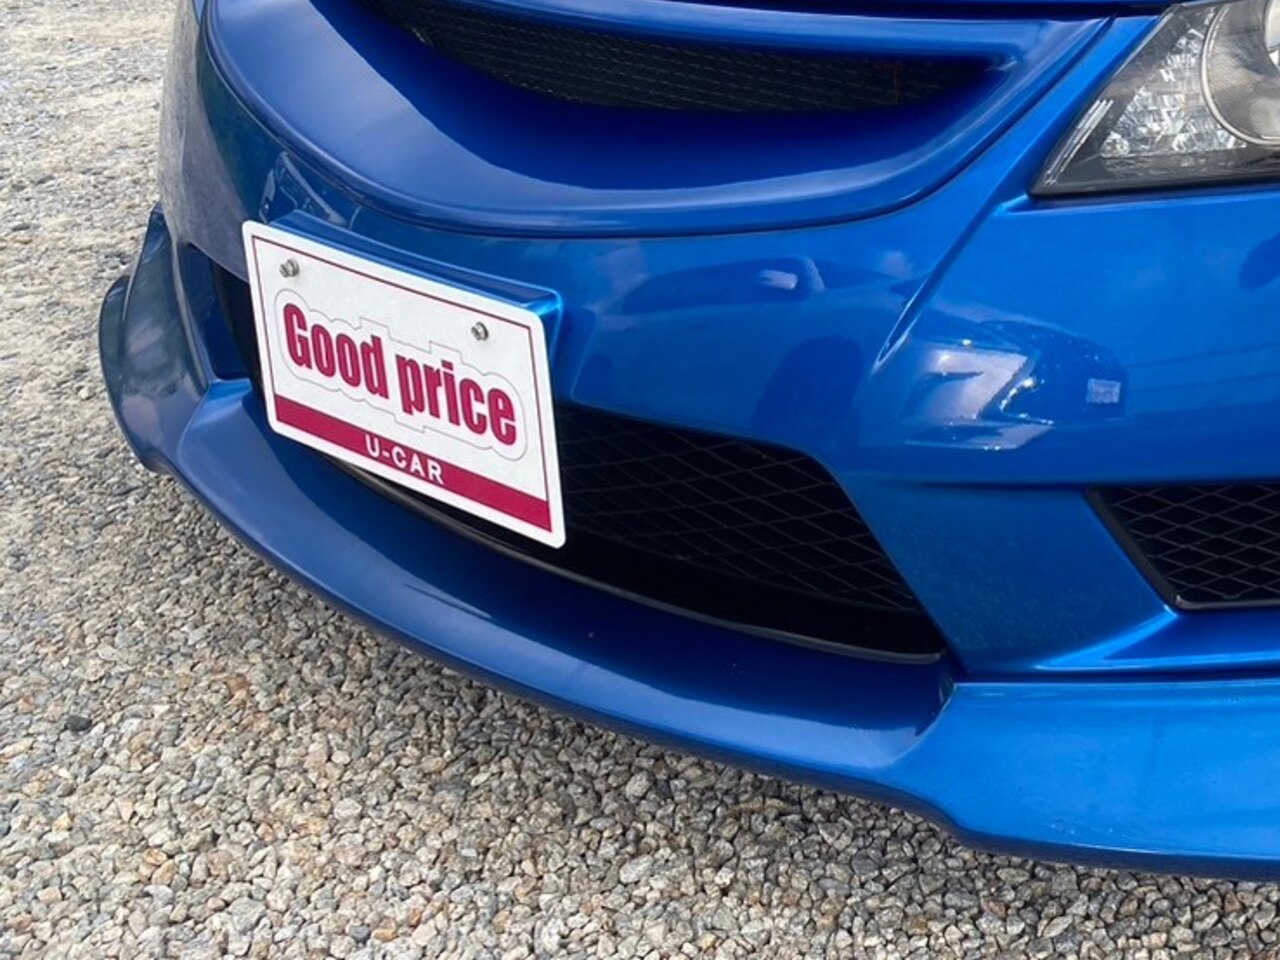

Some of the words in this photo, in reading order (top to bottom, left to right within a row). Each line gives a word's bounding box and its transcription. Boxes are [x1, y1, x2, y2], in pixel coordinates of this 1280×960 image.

[283, 303, 389, 400] Good
[395, 354, 517, 446] price
[364, 434, 445, 486] U-CAR
